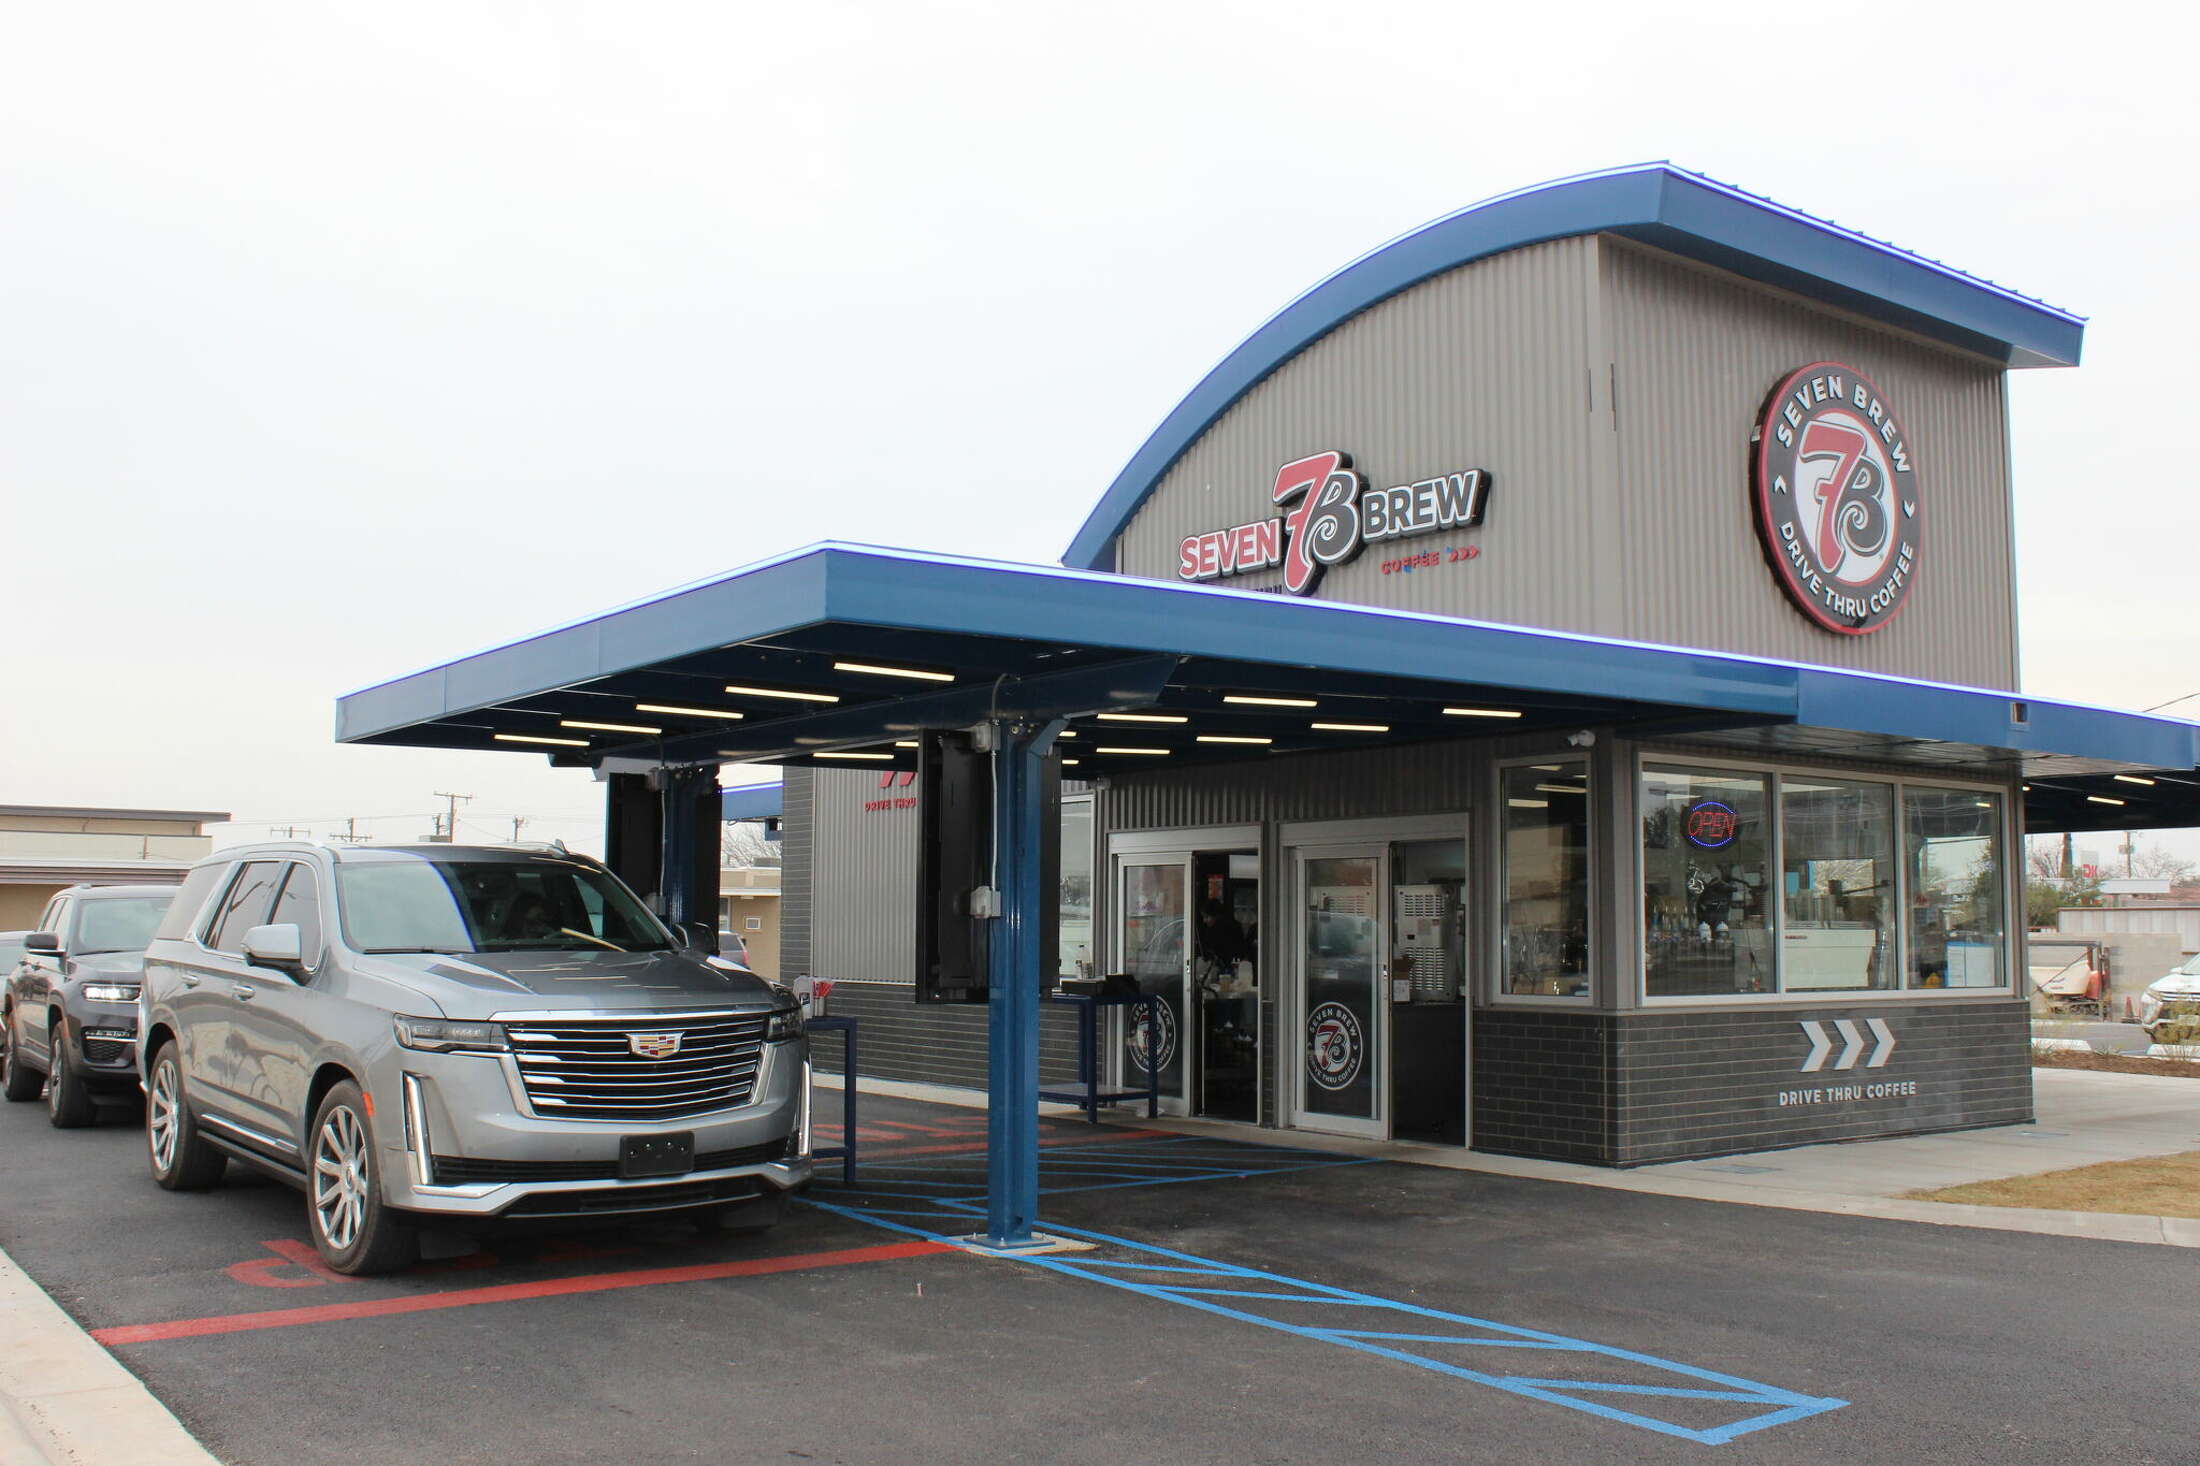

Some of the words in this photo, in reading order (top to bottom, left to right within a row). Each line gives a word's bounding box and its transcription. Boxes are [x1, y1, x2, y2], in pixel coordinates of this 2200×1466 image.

[1777, 376, 1843, 448] SEVEN
[1853, 384, 1911, 474] BREW
[1179, 518, 1282, 580] SEVEN
[1362, 468, 1481, 540] BREW
[1380, 552, 1440, 575] COFFEE
[1780, 521, 1823, 596] DRIVE
[1824, 586, 1867, 618] THRU
[1870, 541, 1914, 614] COFFEE
[865, 799, 891, 812] DRIVE
[893, 797, 917, 809] THRU
[1688, 811, 1736, 838] OPEN
[1309, 1008, 1333, 1033] SEVEN
[1336, 1009, 1357, 1036] BREW
[1779, 1089, 1821, 1106] DRIVE
[1826, 1085, 1862, 1103] THRU
[1866, 1081, 1916, 1099] COFFEE
